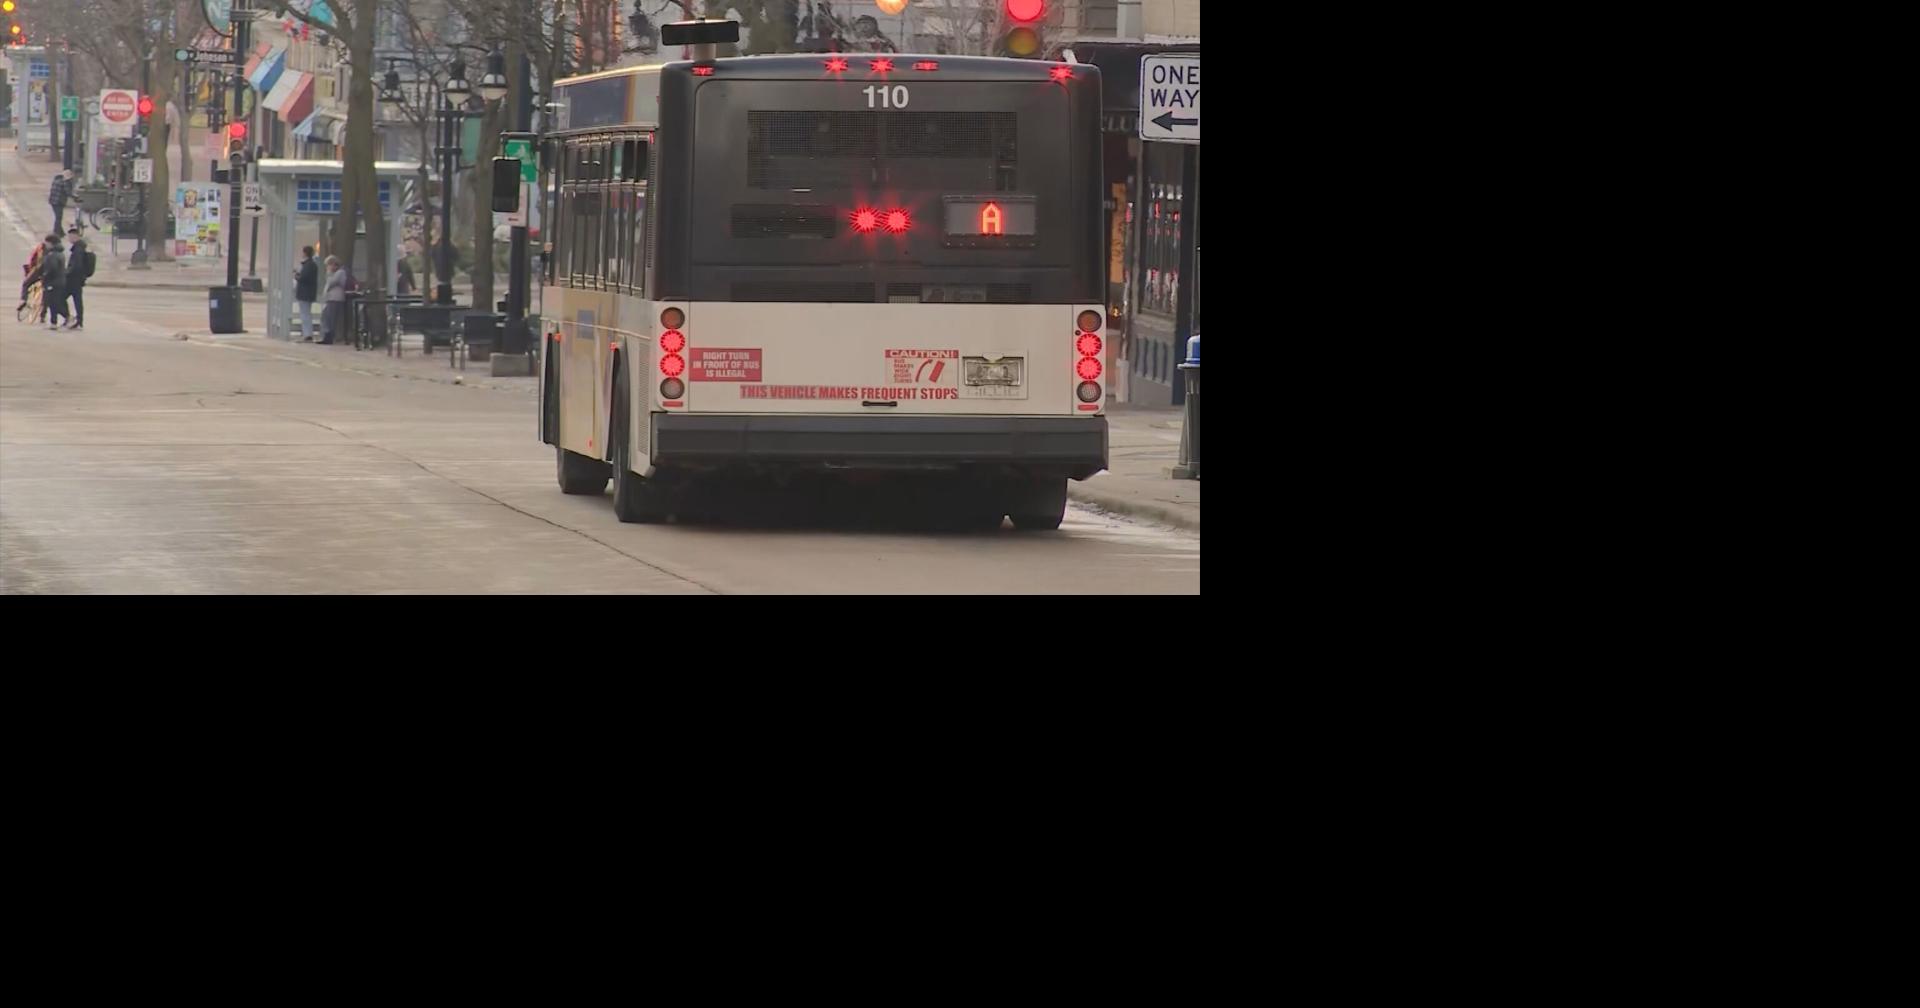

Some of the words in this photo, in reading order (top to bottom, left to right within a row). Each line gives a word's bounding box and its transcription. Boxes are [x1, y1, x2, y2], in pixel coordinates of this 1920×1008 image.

[194, 51, 228, 62] Johnson
[1152, 64, 1199, 85] ONE
[862, 85, 909, 108] 110
[1150, 88, 1199, 108] WAY
[982, 202, 1002, 235] A
[702, 351, 726, 360] RIGHT
[728, 351, 750, 360] TURN
[889, 350, 956, 358] CAUTION!
[692, 360, 702, 369] IN
[703, 360, 729, 369] FRONT
[730, 360, 742, 369] OF
[743, 360, 760, 369] BUS
[705, 369, 714, 377] IS
[715, 369, 747, 378] ILLEGAL
[740, 385, 768, 398] THIS
[770, 386, 816, 399] VEHICLE
[818, 386, 858, 399] MAKES
[861, 387, 918, 400] FREQUENT
[921, 388, 959, 400] STOPS
